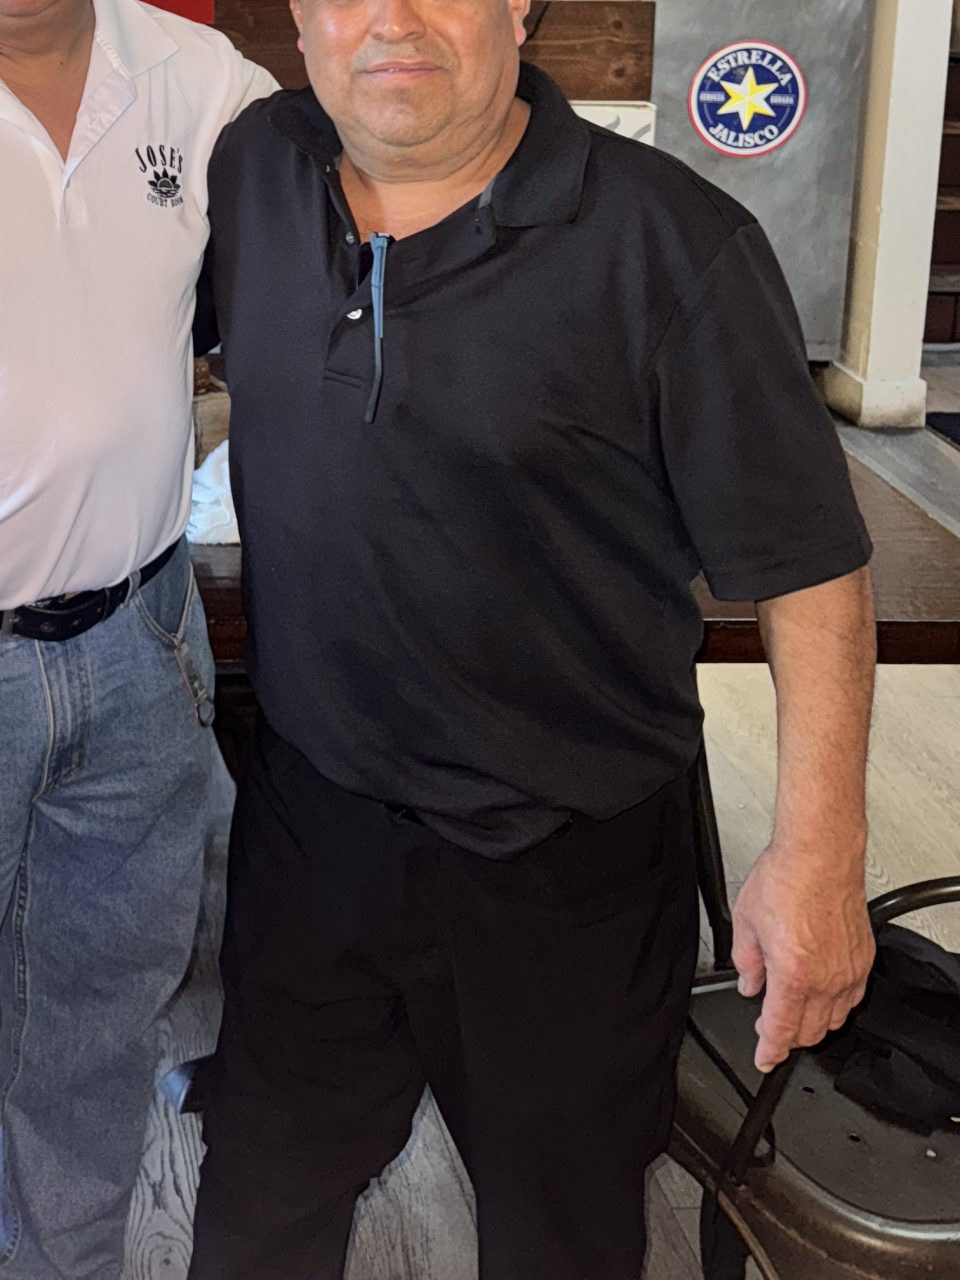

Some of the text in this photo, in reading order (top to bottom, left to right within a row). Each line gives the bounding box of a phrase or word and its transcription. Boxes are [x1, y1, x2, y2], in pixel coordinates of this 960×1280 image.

[706, 49, 794, 87] ESTRELLA
[709, 122, 779, 148] JALISCO
[135, 144, 183, 174] JOSE'S
